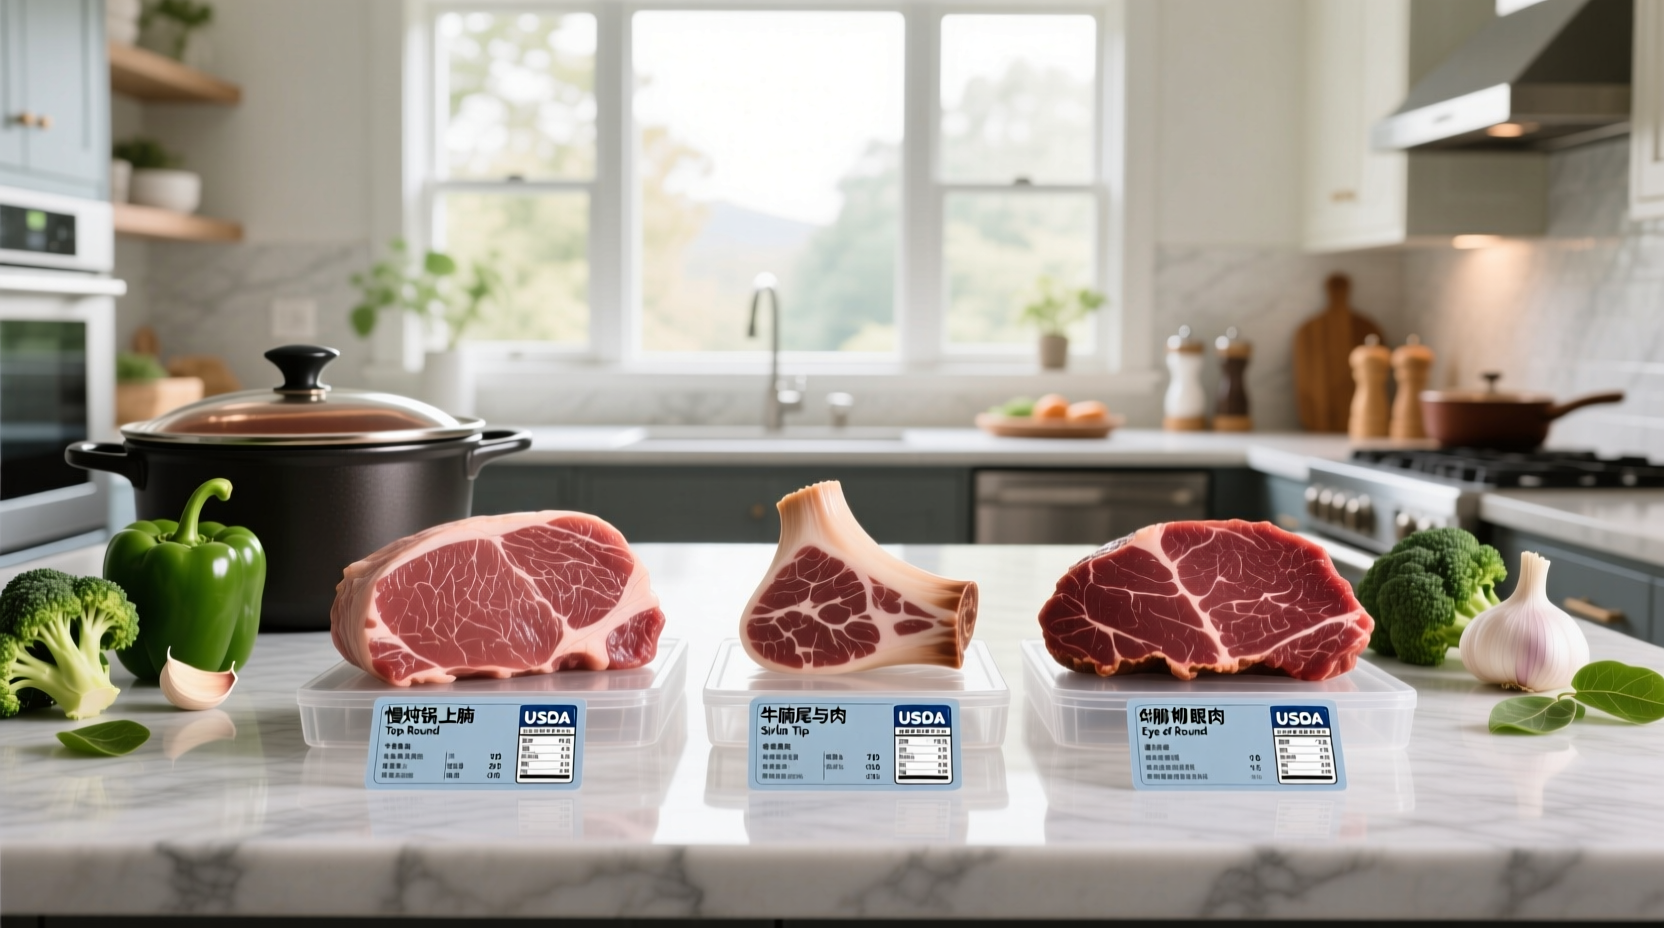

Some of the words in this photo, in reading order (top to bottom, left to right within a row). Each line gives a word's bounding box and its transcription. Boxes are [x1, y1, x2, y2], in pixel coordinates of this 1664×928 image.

[524, 710, 571, 725] USDA
[898, 710, 946, 725] USDA
[1275, 711, 1324, 726] USDA
[385, 725, 404, 737] Top
[407, 725, 440, 735] Round
[1142, 726, 1160, 739] Eye
[1175, 725, 1208, 736] Round
